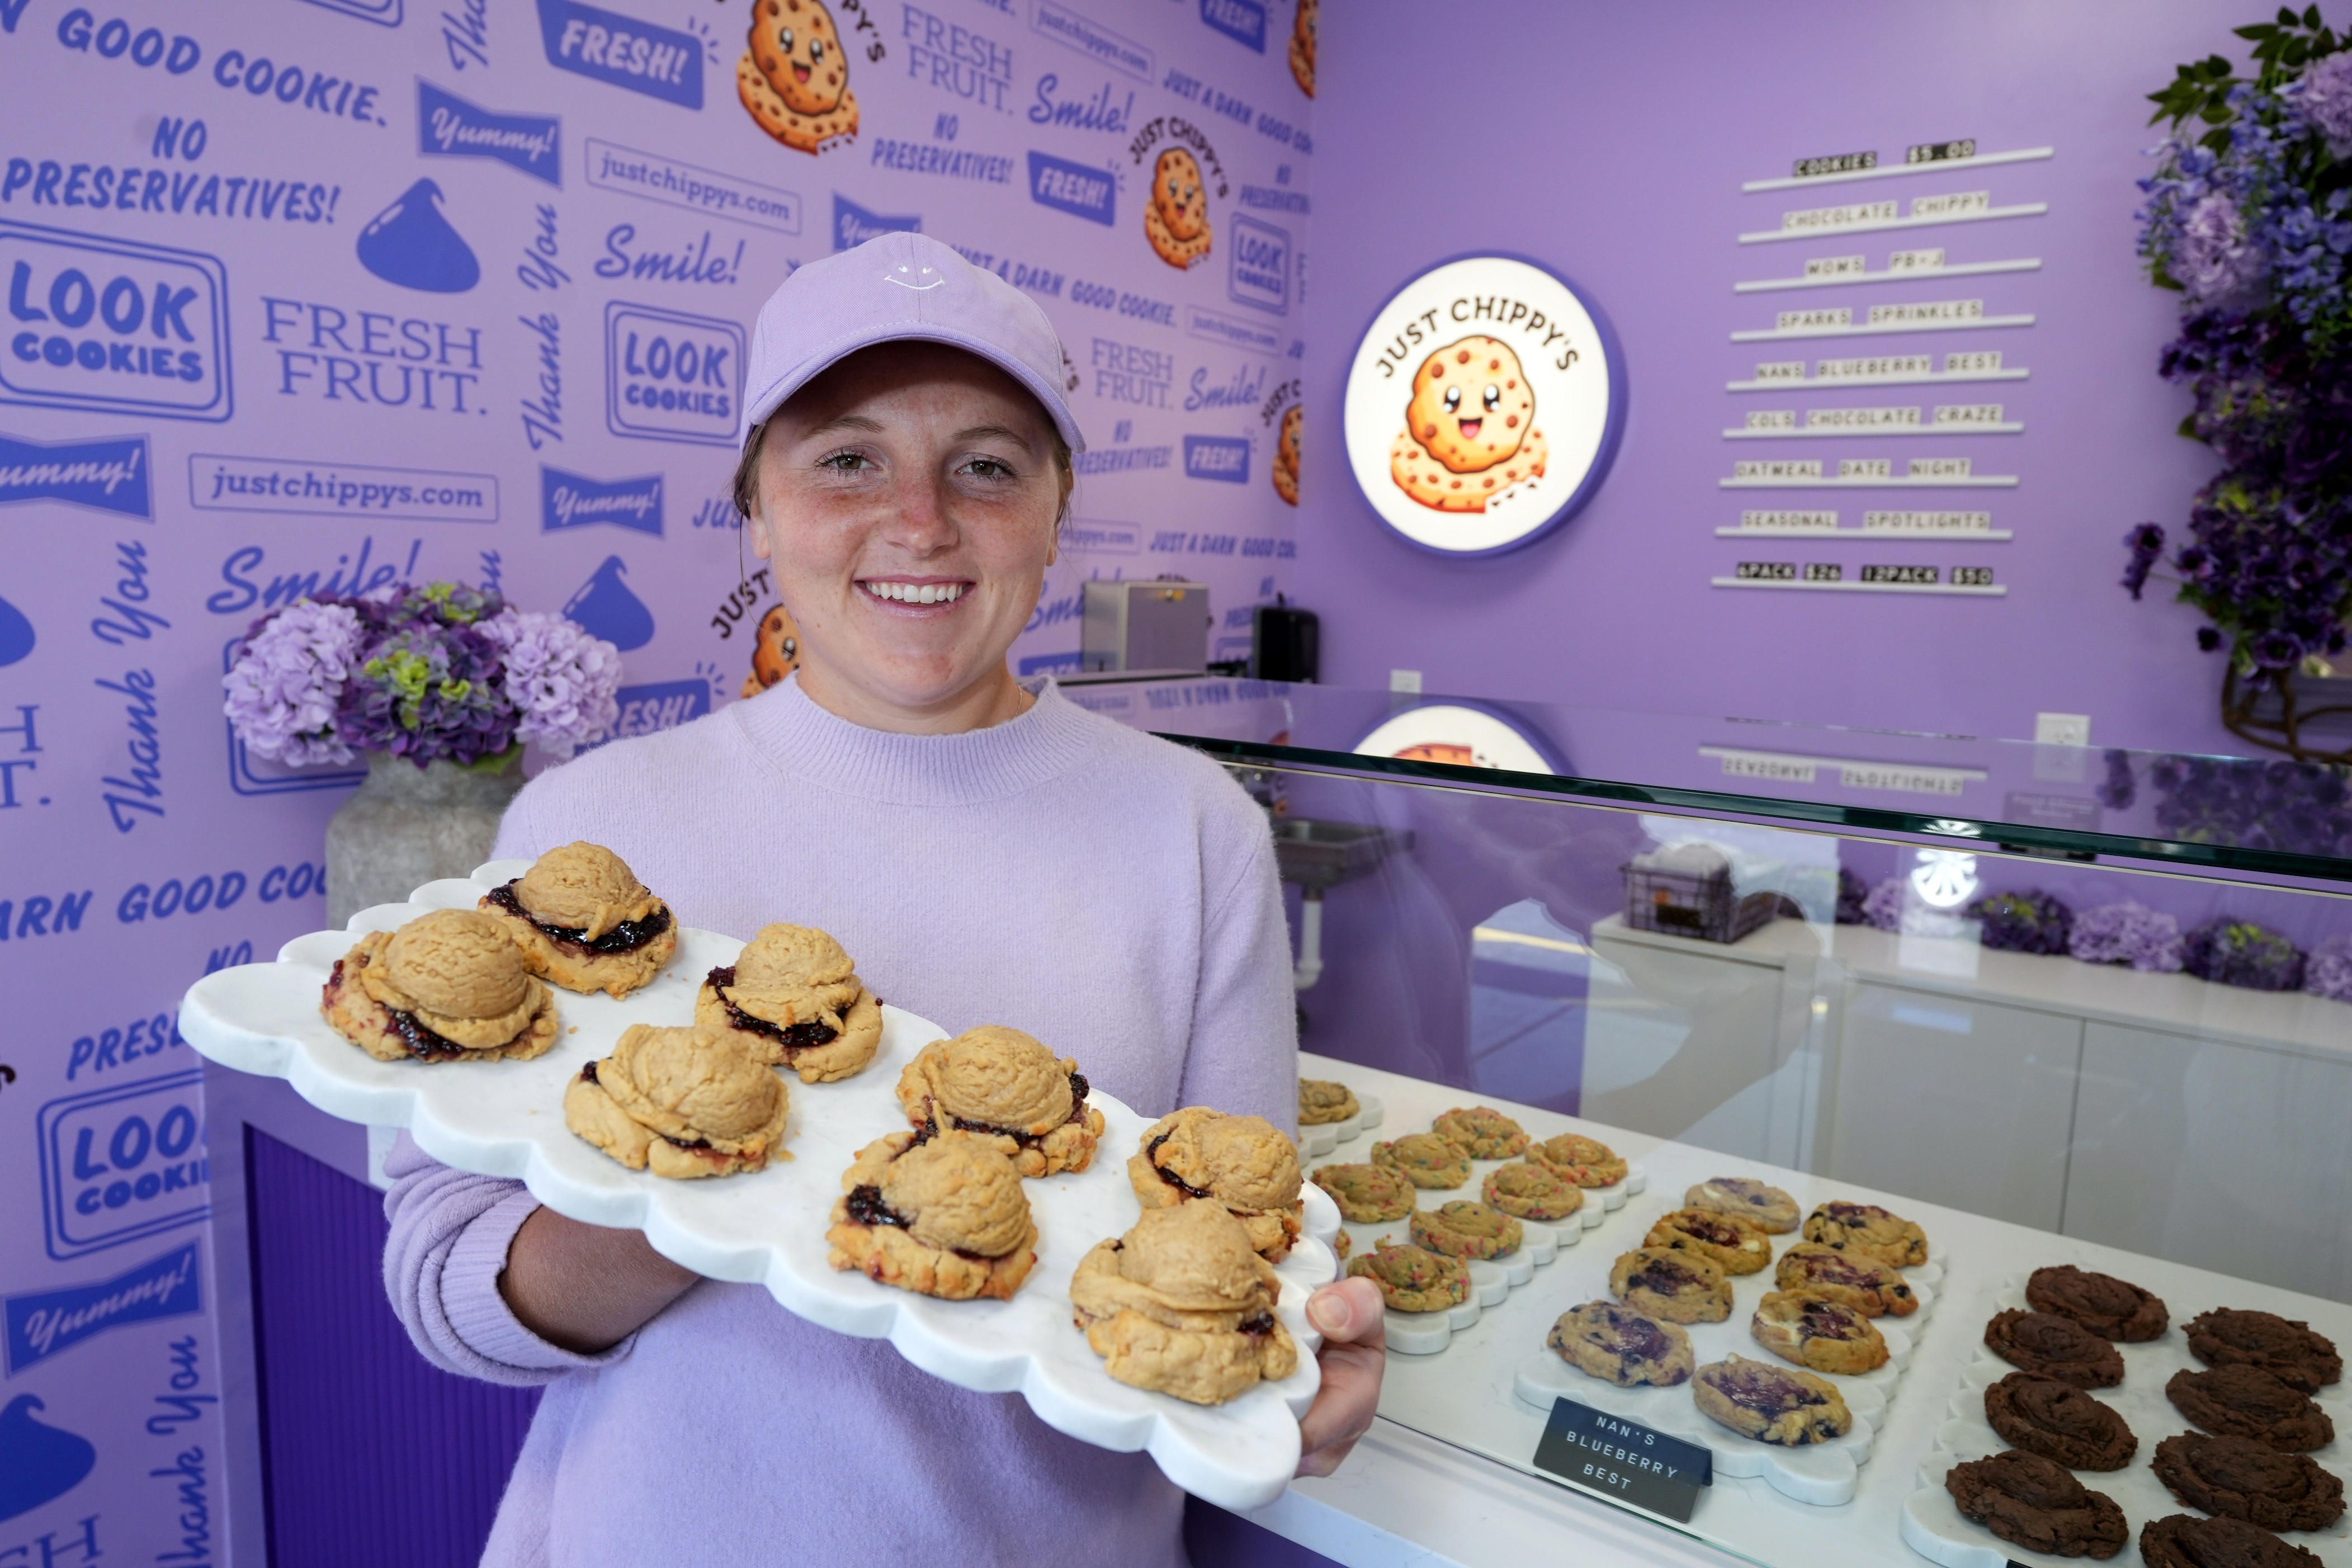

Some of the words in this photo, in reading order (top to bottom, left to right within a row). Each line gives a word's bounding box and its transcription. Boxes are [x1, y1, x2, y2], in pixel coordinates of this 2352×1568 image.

[441, 0, 489, 70] Tha
[560, 18, 689, 85] FRESH!
[903, 2, 1013, 81] FRESH
[57, 8, 201, 74] GOOD
[214, 50, 386, 127] COOKIE.
[909, 42, 1014, 116] FRUIT.
[933, 112, 959, 141] NO
[1028, 73, 1135, 134] Smile!
[152, 116, 207, 161] NO
[432, 107, 556, 161] Yummy!
[871, 138, 1014, 184] PRESERVATIVES!
[1794, 151, 1877, 177] COOKIES
[1907, 140, 1976, 164] $5.00
[2, 157, 341, 224] PRESERVATIVES!
[600, 150, 790, 221] justchippys.com
[1038, 167, 1108, 209] FRESH!
[1787, 202, 1893, 229] CHOCOLATE
[1914, 195, 1986, 216] CHIPPY
[517, 204, 573, 291] You
[594, 223, 745, 284] Smile!
[9, 259, 198, 343] LOOK
[1071, 280, 1116, 311] GOOD
[1782, 310, 1848, 328] SPARKS
[1872, 300, 1981, 323] SPRINKLES
[11, 332, 204, 382] COOKIES
[260, 296, 483, 369] FRESH
[625, 332, 730, 389] LOOK
[1092, 337, 1173, 382] FRESH
[1376, 308, 1439, 379] JUST
[1451, 295, 1580, 371] CHIPPY'S
[277, 349, 487, 416] FRUIT.
[518, 313, 563, 450] Thank
[1184, 363, 1267, 413] Smile!
[1758, 365, 1803, 380] NANS
[1819, 358, 1931, 377] BLUEBERRY
[1948, 353, 1999, 371] BEST
[625, 383, 730, 418] COOKIES
[1808, 408, 1916, 427] CHOCOLATE
[1936, 406, 1998, 423] CRAZE
[212, 466, 483, 509] justchippys.com
[1736, 462, 1818, 477] OATMEAL
[1840, 461, 1887, 476] DATE
[1910, 460, 1968, 475] NIGHT
[552, 483, 659, 526] Yummy!
[1744, 513, 1835, 528] SEASONAL
[1867, 513, 1988, 529] SPOTLIGHTS
[91, 540, 171, 646] You
[206, 535, 422, 614] Smile!
[711, 568, 770, 639] JUST
[94, 668, 165, 834] Thank
[116, 871, 247, 923] GOOD
[73, 1104, 207, 1181] LOO
[24, 1252, 191, 1355] Yummy!
[145, 1335, 219, 1435] You
[1567, 1431, 1678, 1478] BLUEBERRY
[1597, 1416, 1655, 1446] NAN'S
[1583, 1463, 1631, 1490] BEST
[149, 1446, 212, 1568] hank
